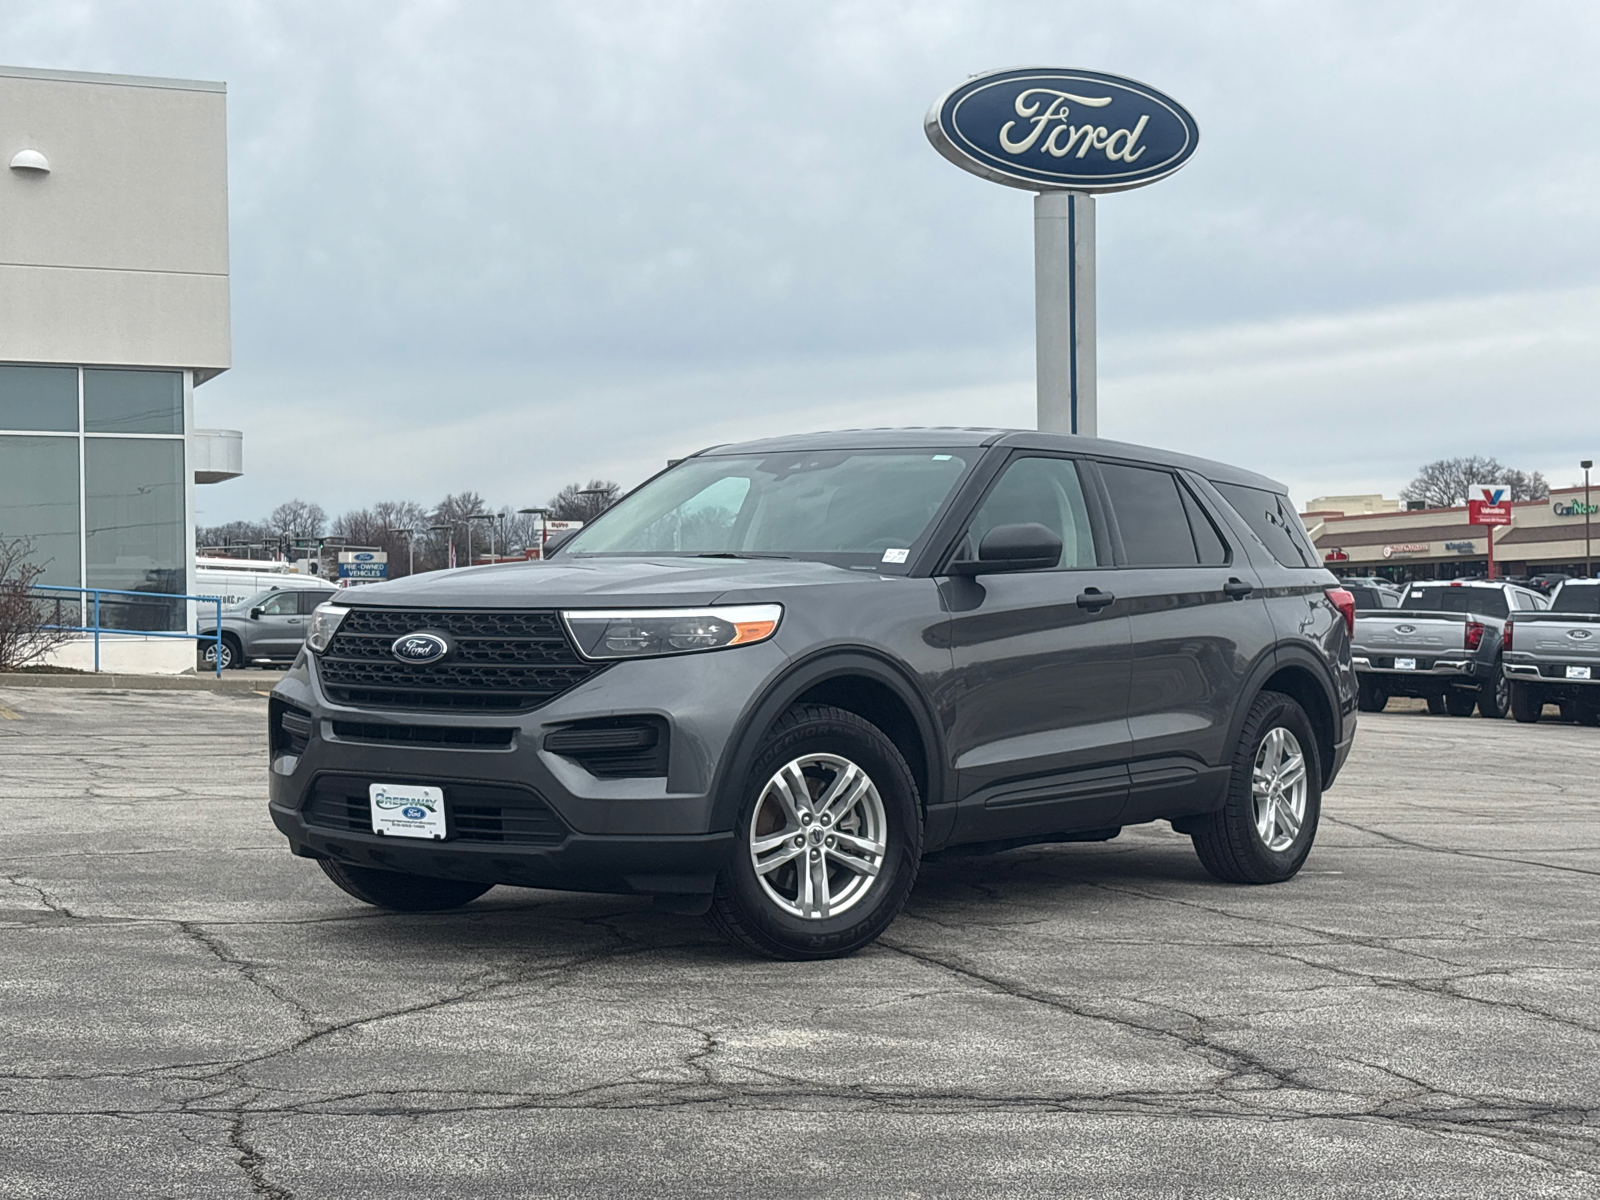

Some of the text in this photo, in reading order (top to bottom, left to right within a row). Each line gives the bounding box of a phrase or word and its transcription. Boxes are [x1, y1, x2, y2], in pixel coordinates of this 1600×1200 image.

[999, 88, 1150, 164] Ford
[402, 639, 433, 656] Ford
[1535, 640, 1600, 651] F-15
[407, 808, 421, 818] Ford
